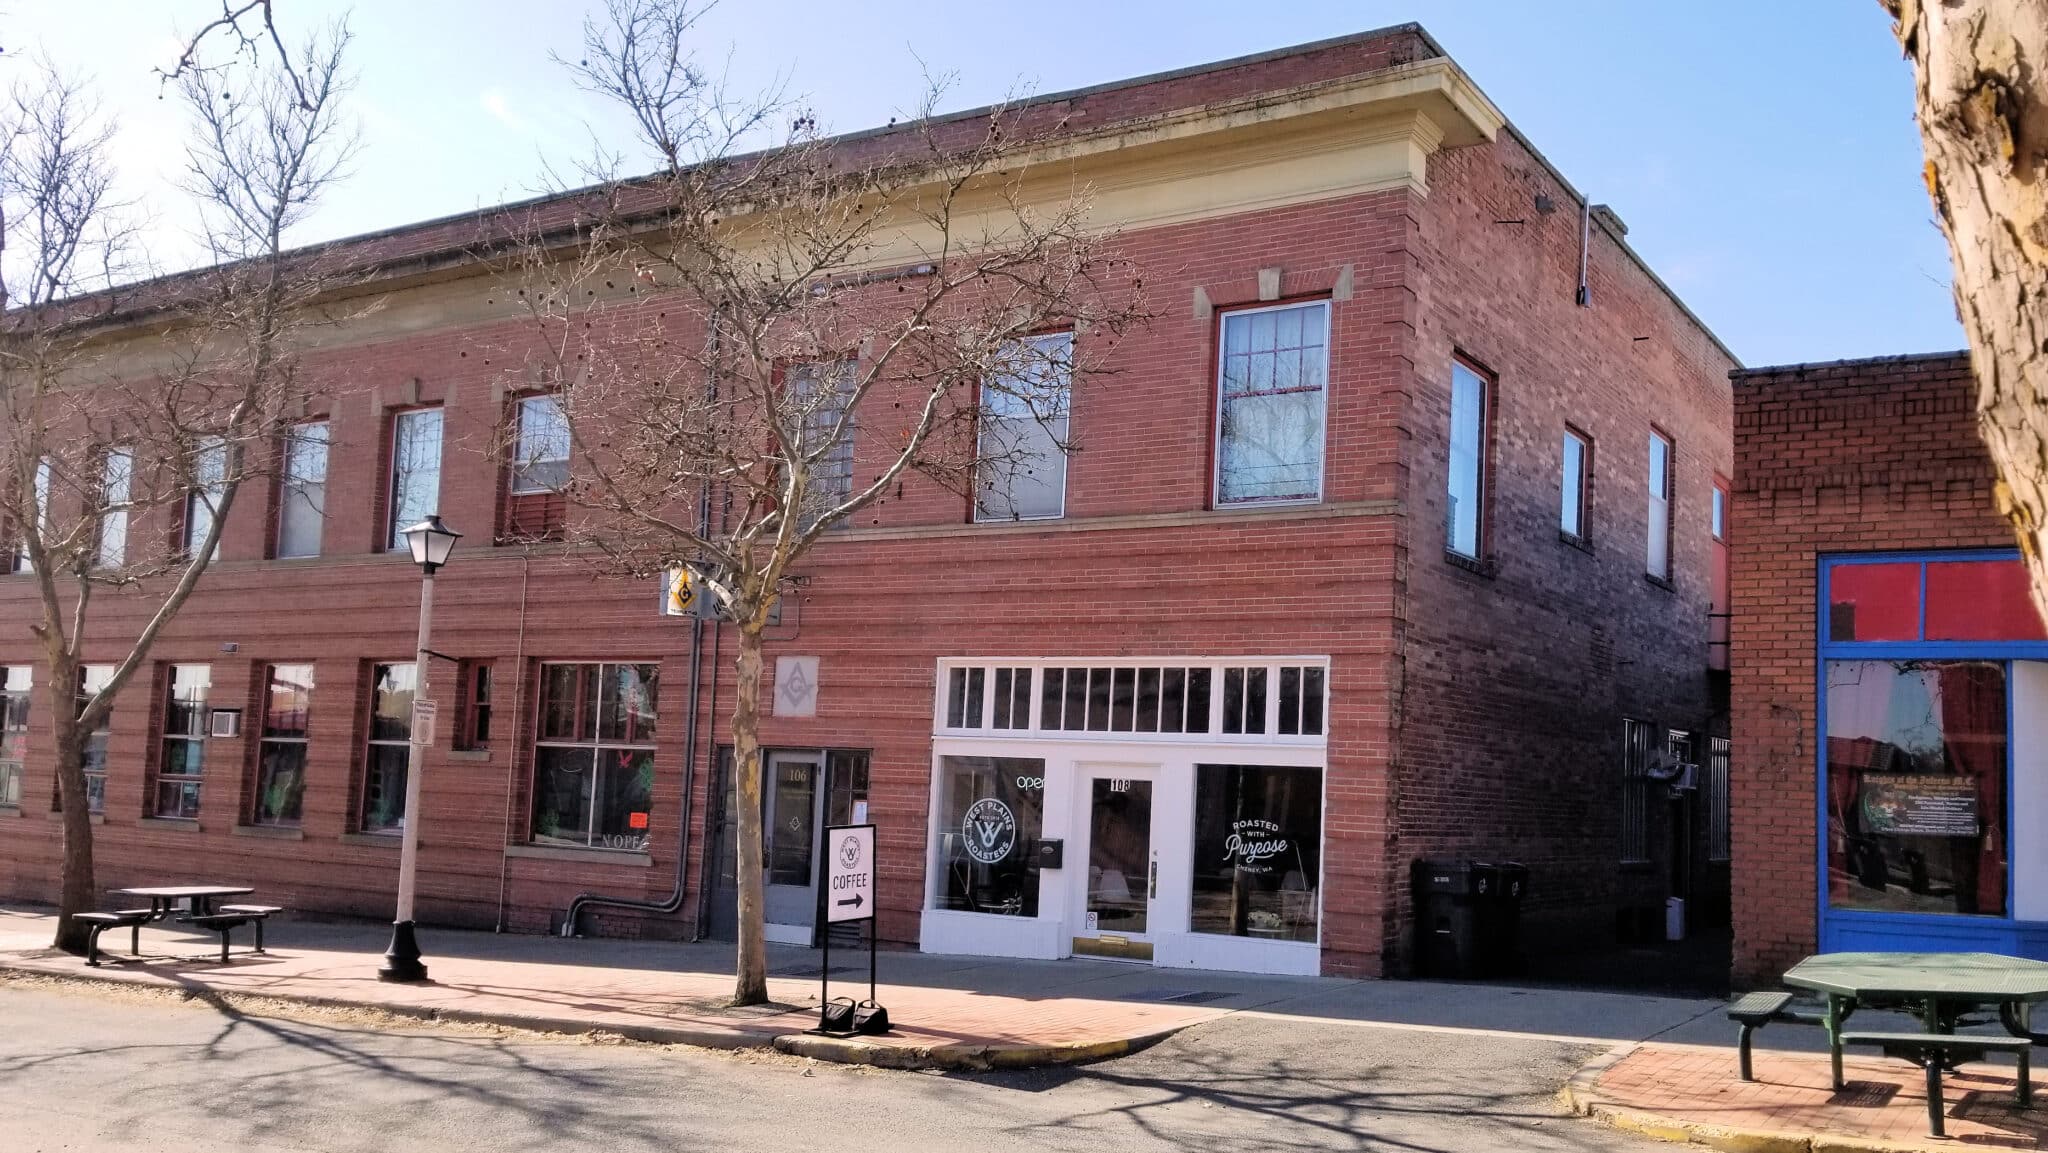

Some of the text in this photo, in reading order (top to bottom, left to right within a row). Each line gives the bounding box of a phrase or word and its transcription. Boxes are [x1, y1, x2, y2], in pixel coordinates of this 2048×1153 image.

[790, 769, 807, 782] 106
[1112, 779, 1129, 792] 108
[966, 802, 1012, 831] WEST PLAINS
[1233, 819, 1279, 832] ROASTED
[967, 838, 1009, 860] ROASTERS
[1222, 834, 1288, 864] Purpose
[833, 873, 867, 890] COFFEE
